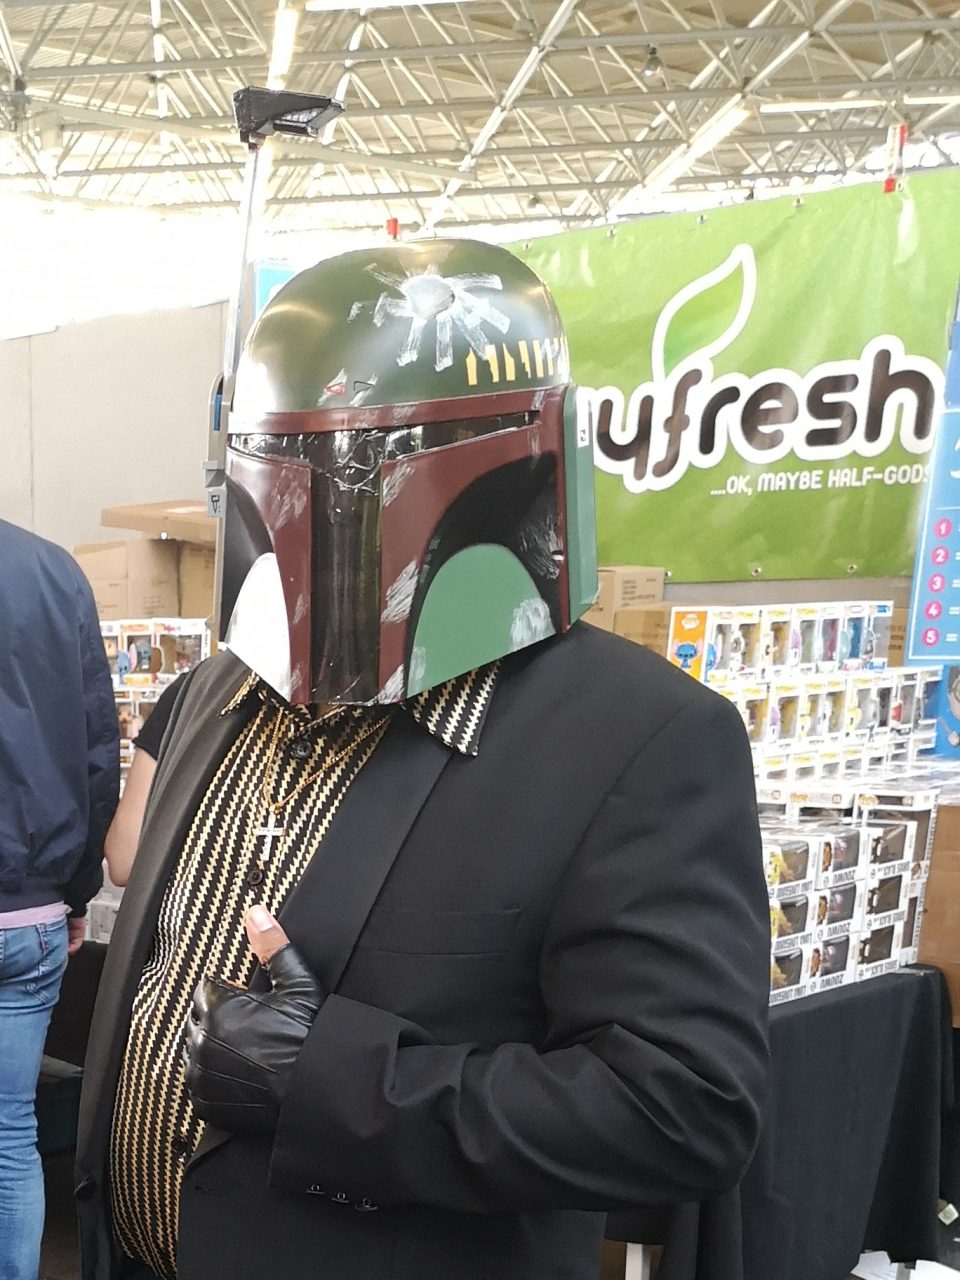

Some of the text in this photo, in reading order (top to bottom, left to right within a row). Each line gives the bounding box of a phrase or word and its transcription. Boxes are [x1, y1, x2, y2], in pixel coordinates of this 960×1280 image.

[757, 469, 823, 492] MAYBE
[833, 870, 856, 882] ZOUWU
[883, 864, 896, 877] BLACK
[800, 881, 813, 893] LUNA
[879, 914, 892, 926] BLACK
[827, 923, 851, 937] ZOUWU
[800, 933, 813, 946] LUNA
[871, 964, 884, 976] BLACK
[820, 974, 845, 988] ZOUWU
[793, 985, 807, 998] LUNA
